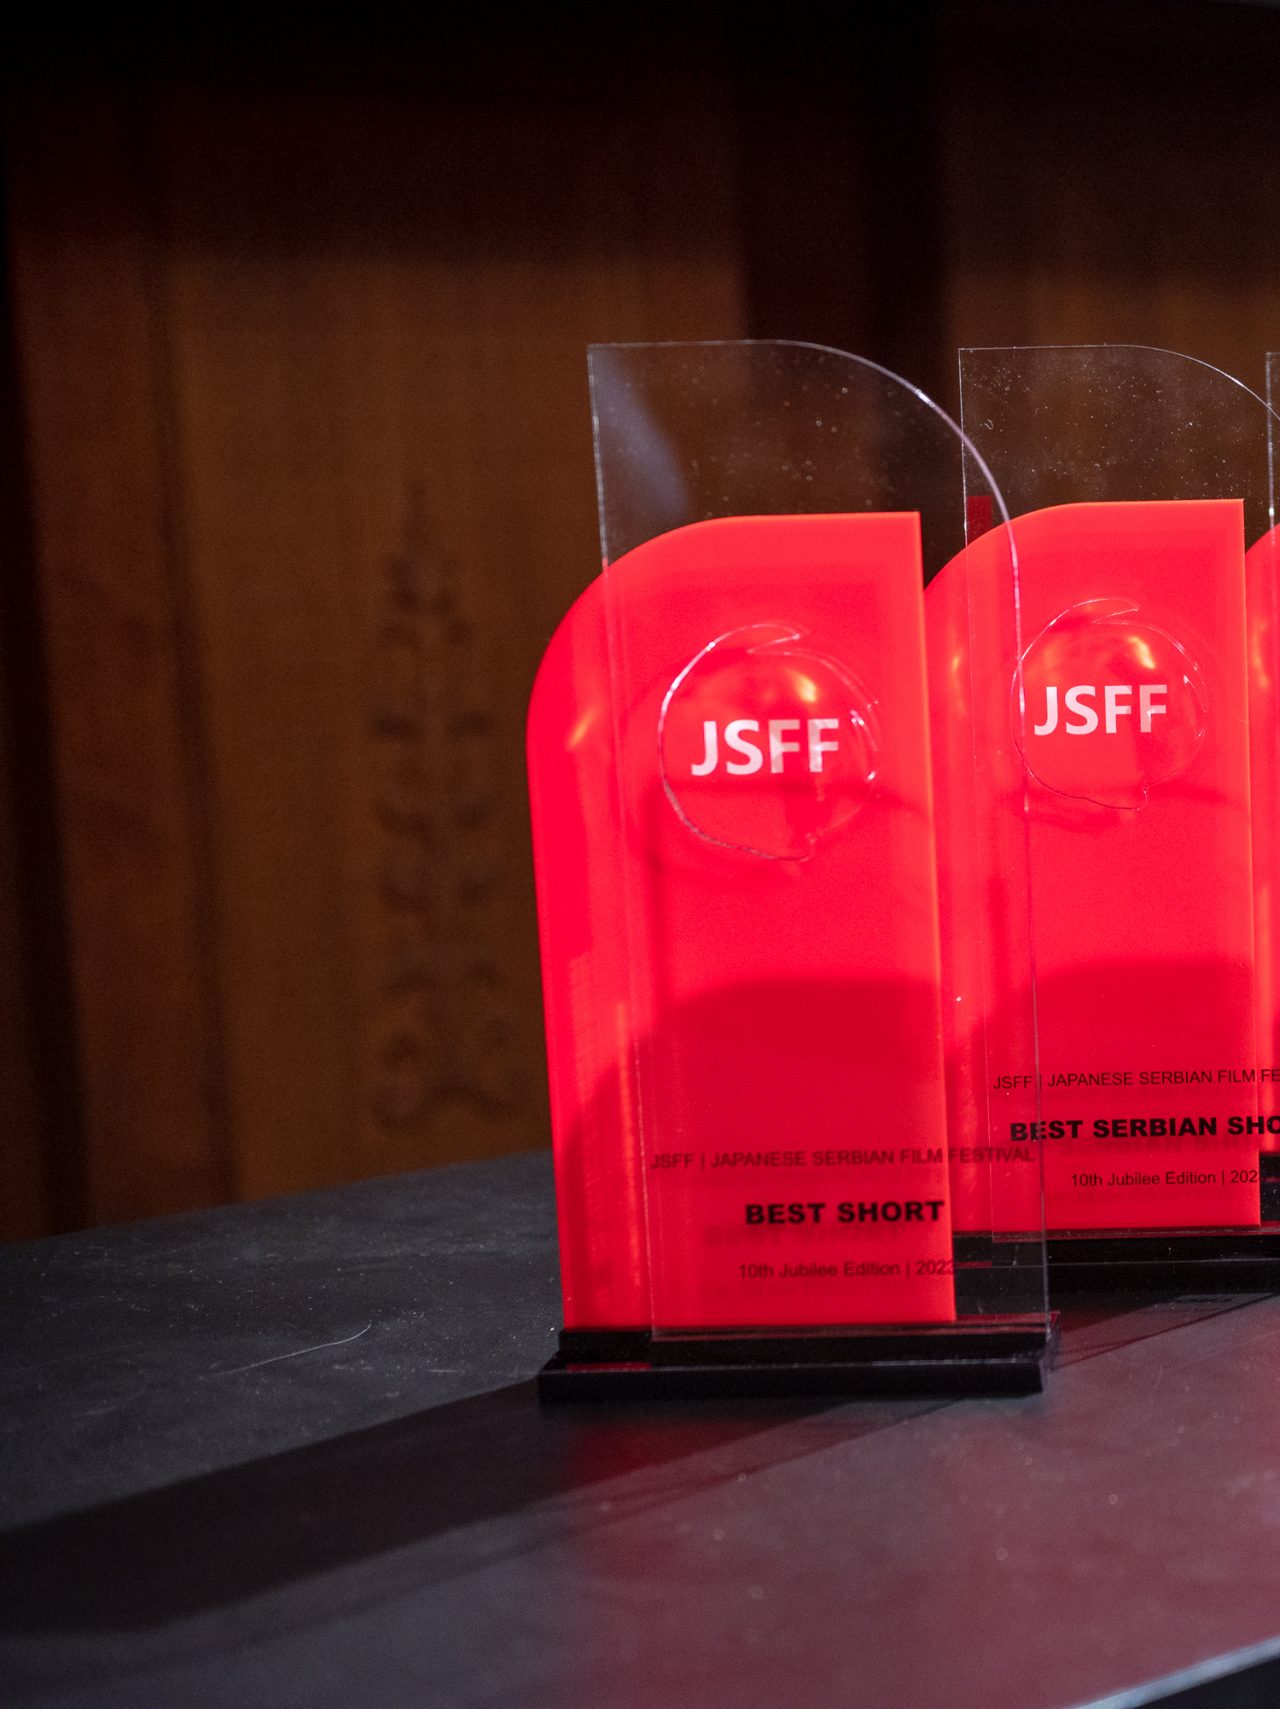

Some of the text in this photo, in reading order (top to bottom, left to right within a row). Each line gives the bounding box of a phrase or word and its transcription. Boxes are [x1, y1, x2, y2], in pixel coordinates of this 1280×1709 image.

[1033, 684, 1169, 737] JSFF
[690, 717, 840, 776] JSFF
[993, 1075, 1033, 1090] JSFF
[1047, 1072, 1134, 1087] JAPANESE
[1139, 1070, 1213, 1085] SERBIAN
[1218, 1069, 1256, 1084] FILM
[1010, 1120, 1084, 1141] BEST
[1093, 1117, 1217, 1139] SERBIAN
[650, 1152, 695, 1171] JSFF
[710, 1150, 806, 1168] JAPANESE
[812, 1149, 895, 1166] SERBIAN
[899, 1148, 943, 1165] FILM
[948, 1147, 1035, 1164] FESTIVAL
[1071, 1173, 1103, 1187] 10th
[1107, 1172, 1161, 1187] Jubilee
[1165, 1170, 1216, 1185] Edition
[745, 1201, 945, 1225] BEST SHORT
[739, 1262, 774, 1279] 10th
[778, 1261, 837, 1278] Jubilee
[843, 1260, 900, 1277] Edition
